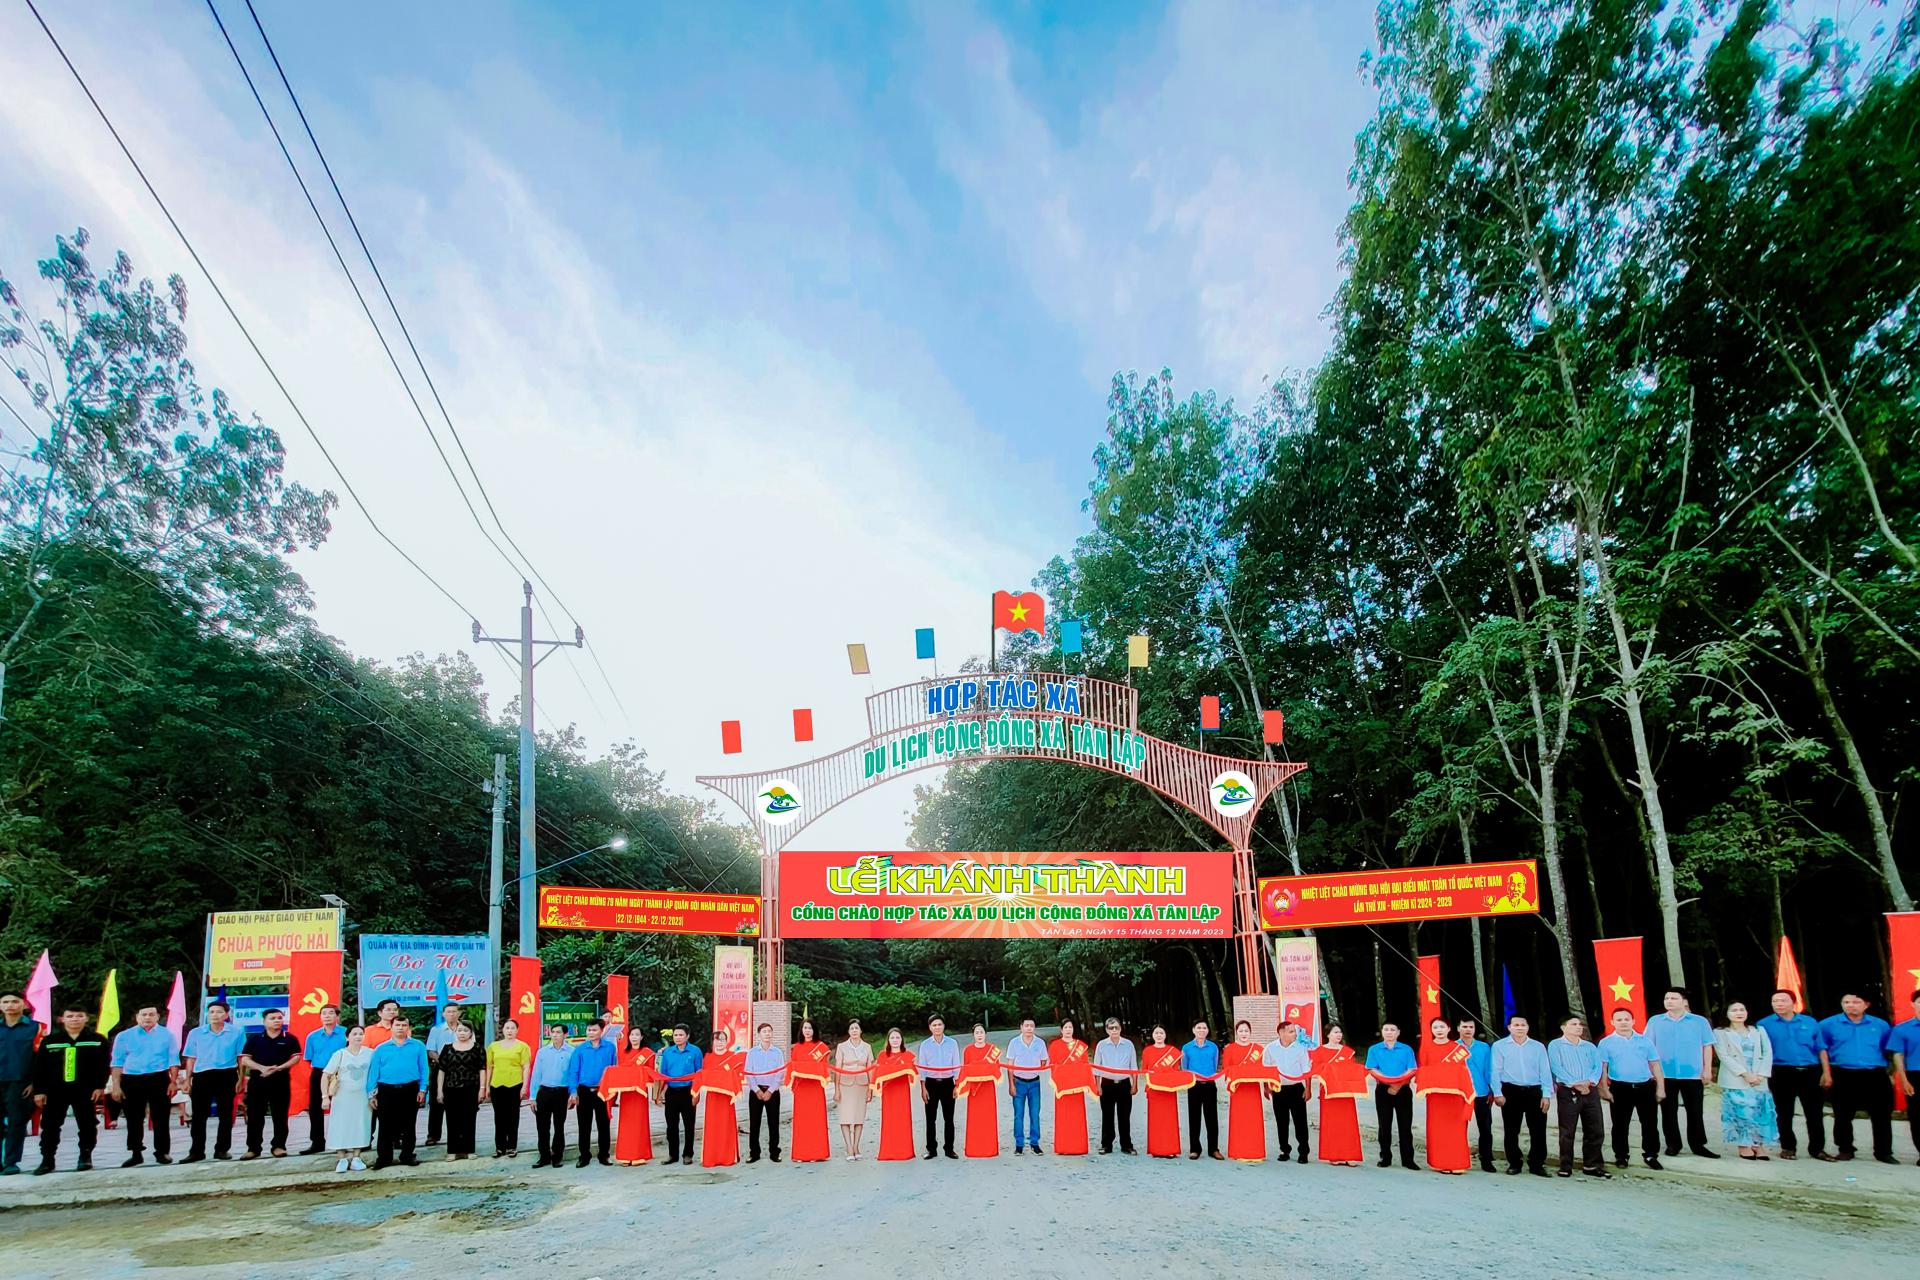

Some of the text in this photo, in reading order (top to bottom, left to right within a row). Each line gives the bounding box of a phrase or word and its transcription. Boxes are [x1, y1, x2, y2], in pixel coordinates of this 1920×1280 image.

[928, 675, 1082, 716] HỢP TÁC XÃ
[864, 711, 1147, 779] DU LỊCH CỘNG ĐỒNG XÃ TÂN LẬP
[827, 856, 1186, 895] LỄ KHÁNH THÀNH
[1487, 875, 1503, 888] NAM
[315, 911, 333, 921] NAM
[792, 902, 1220, 922] CỔNG CHÀO HỢP TÁC XÃ DU LỊCH CỘNG ĐỒNG XÃ TÂN LẬP
[217, 927, 329, 953] CHÙA PHƯỚC HẢI
[1130, 927, 1162, 935] THÁNG
